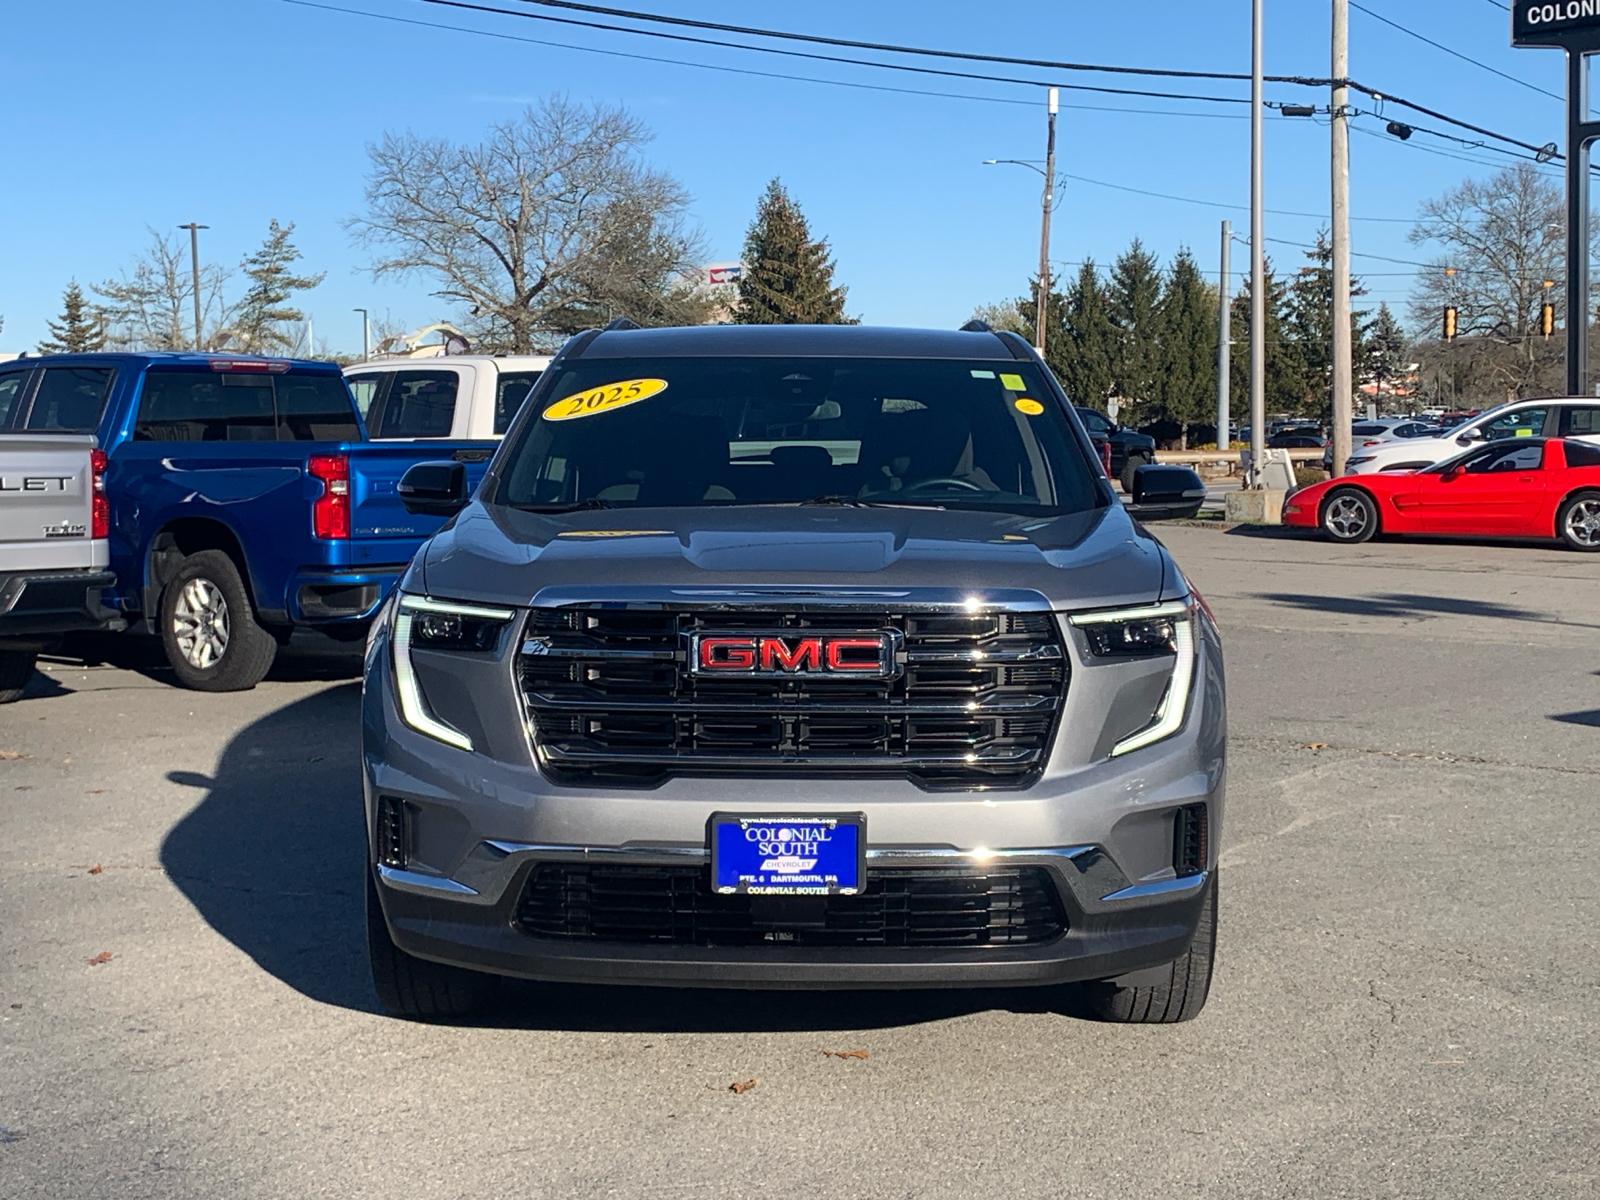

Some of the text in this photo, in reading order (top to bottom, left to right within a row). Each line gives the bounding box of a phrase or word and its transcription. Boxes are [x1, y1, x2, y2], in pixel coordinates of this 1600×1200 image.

[566, 381, 643, 416] 2025
[701, 637, 884, 673] GMC
[745, 828, 832, 842] COLONIAL
[758, 842, 818, 856] SOUTH
[759, 875, 764, 883] 6
[770, 875, 824, 883] DARTMOUTH,
[824, 874, 838, 883] MA
[747, 886, 829, 895] COLONIAL SOUTH
